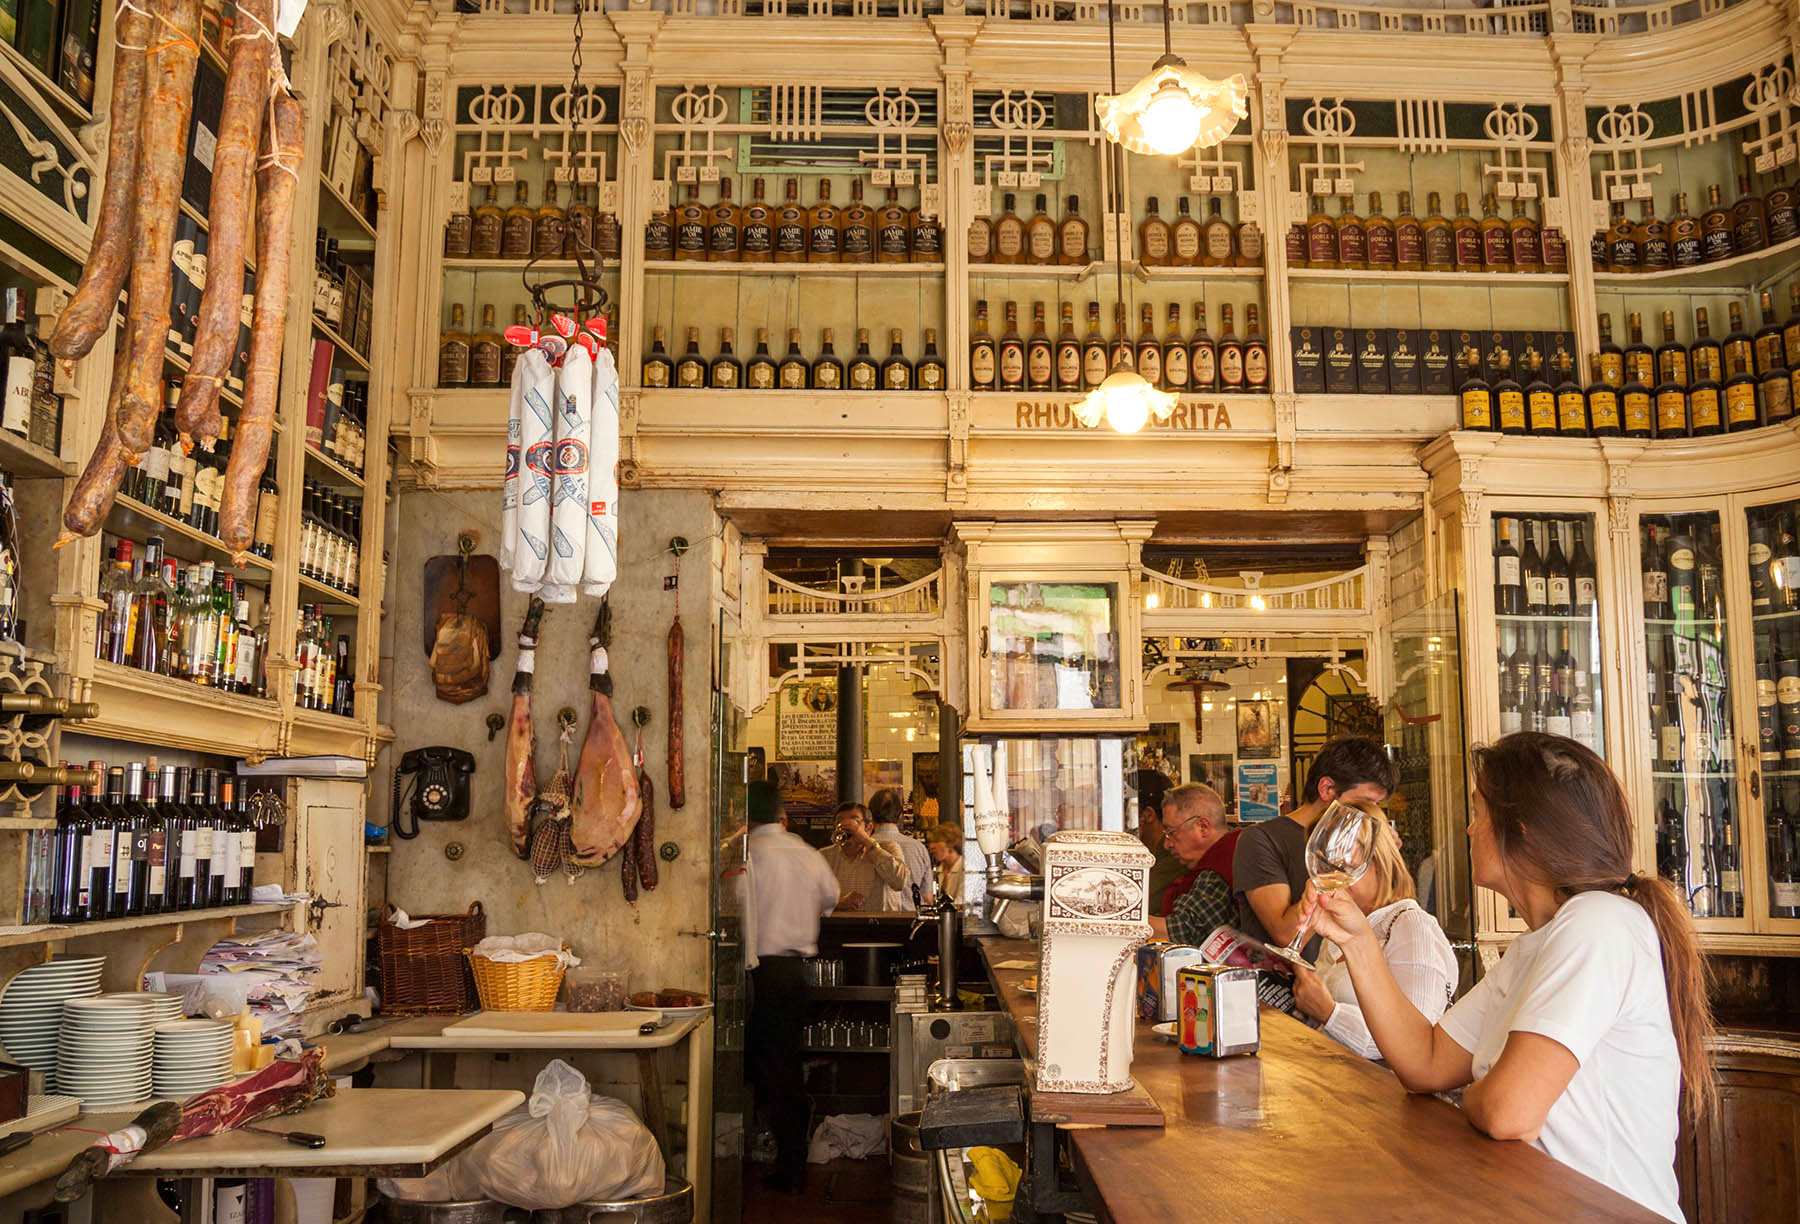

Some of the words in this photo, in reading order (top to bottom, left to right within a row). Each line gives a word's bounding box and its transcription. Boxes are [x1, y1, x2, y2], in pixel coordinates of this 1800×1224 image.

[682, 226, 703, 234] JAMIE
[747, 227, 768, 235] JAMIE
[1707, 231, 1727, 242] JAMIE
[1615, 242, 1635, 250] JAMIE
[1677, 240, 1698, 250] JAMIE
[1151, 402, 1232, 430] GRITA
